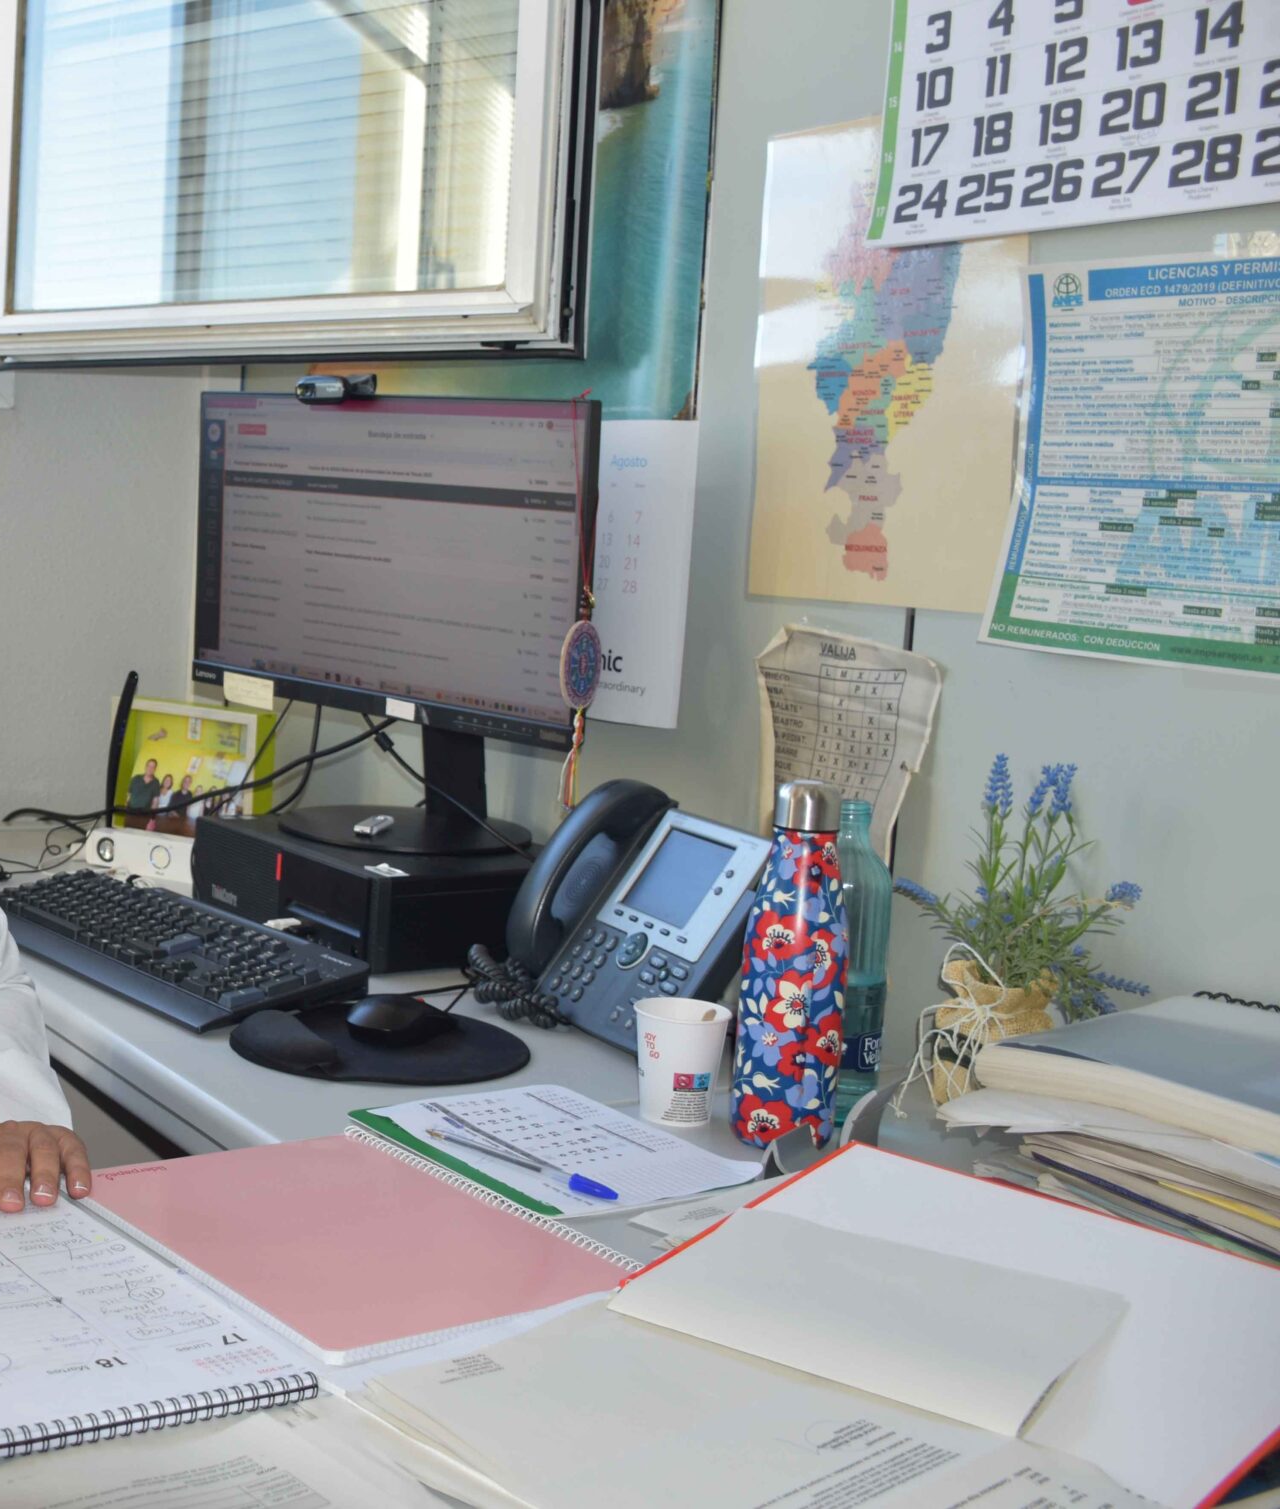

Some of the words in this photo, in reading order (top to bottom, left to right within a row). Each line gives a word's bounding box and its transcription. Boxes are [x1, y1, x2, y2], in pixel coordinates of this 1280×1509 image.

[925, 10, 952, 54] 3
[916, 66, 954, 112] 10
[985, 53, 1011, 98] 11
[1044, 36, 1088, 86] 12
[1116, 18, 1163, 71] 13
[1194, 0, 1244, 55] 14
[911, 122, 949, 167] 17
[973, 111, 1013, 157] 18
[1039, 98, 1082, 146] 19
[1099, 82, 1167, 136] 20
[1185, 67, 1240, 122] 21
[893, 179, 948, 224] 24
[954, 169, 1015, 216] 25
[1020, 158, 1084, 208] 26
[1091, 146, 1160, 198] 27
[1168, 133, 1242, 188] 28
[1148, 265, 1218, 281] LICENCIAS
[1222, 264, 1231, 275] Y
[1105, 287, 1138, 298] ORDEN
[1140, 285, 1161, 296] ECD
[1178, 297, 1216, 308] MOTIVO
[610, 455, 648, 470] Agosto
[991, 622, 1005, 632] NO
[1083, 634, 1104, 644] CON
[1105, 637, 1160, 652] DEDUCCIÓN
[820, 642, 856, 660] VALIJA
[643, 1032, 657, 1041] JOY
[645, 1042, 655, 1050] TO
[649, 1051, 660, 1060] GO
[221, 1332, 248, 1345] 17
[95, 1356, 128, 1368] 18
